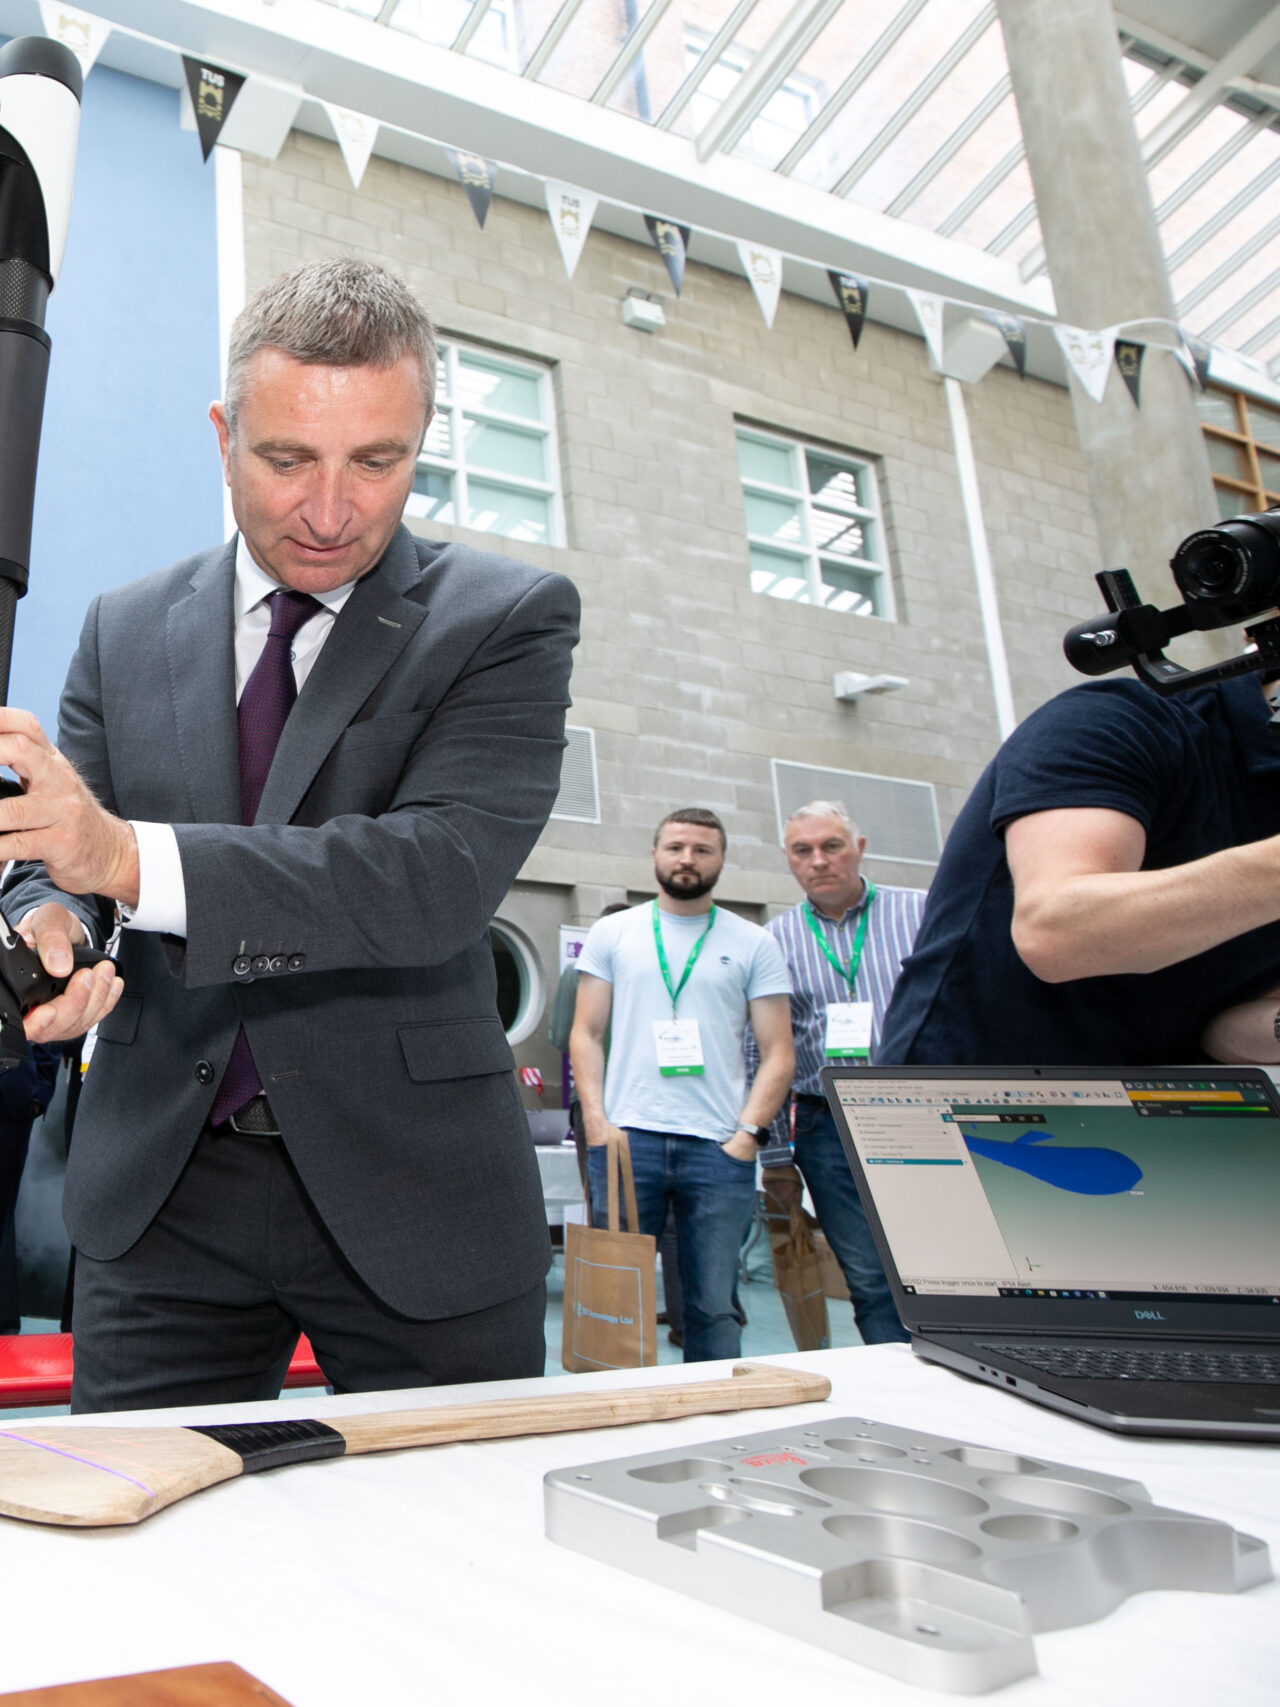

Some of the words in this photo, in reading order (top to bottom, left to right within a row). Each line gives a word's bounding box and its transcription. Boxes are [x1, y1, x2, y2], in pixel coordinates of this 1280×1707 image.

[200, 67, 225, 88] TUS
[561, 194, 580, 208] TUS
[1133, 1310, 1166, 1320] DELL
